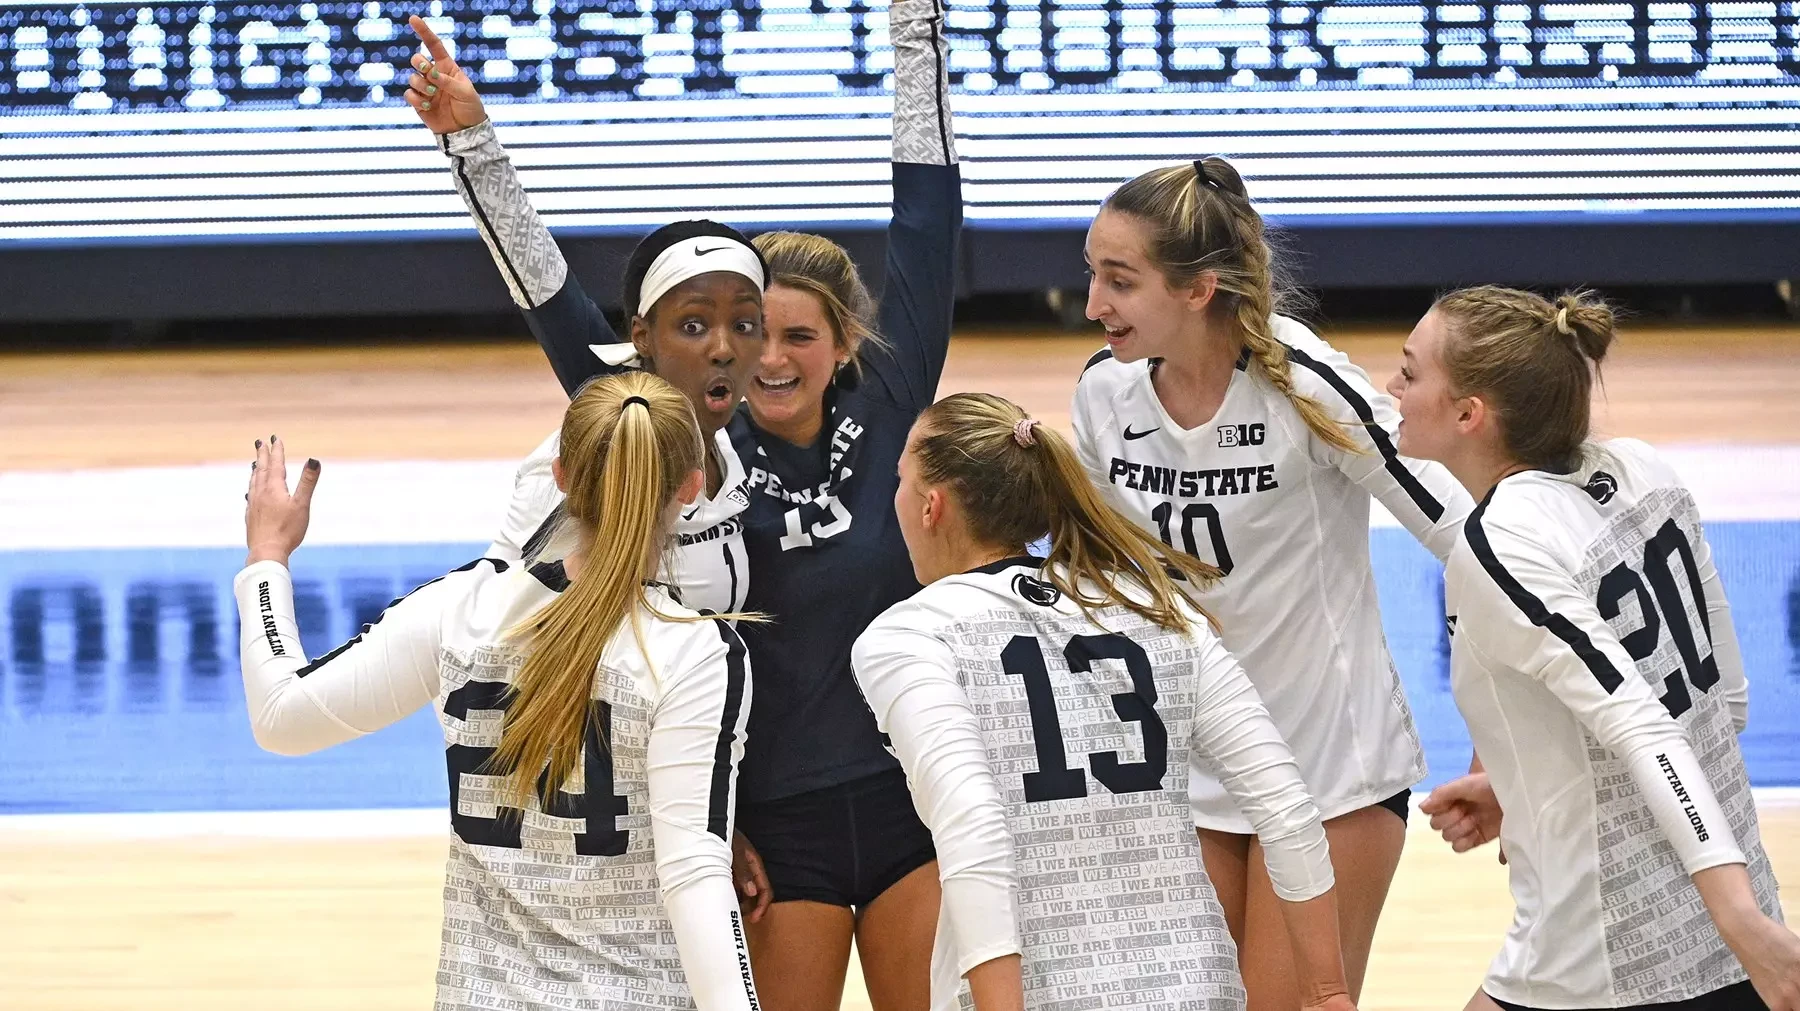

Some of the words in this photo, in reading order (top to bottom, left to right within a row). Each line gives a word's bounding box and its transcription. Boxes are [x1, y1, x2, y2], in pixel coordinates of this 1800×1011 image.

[1109, 457, 1176, 496] PENN
[1178, 464, 1278, 498] STATE
[259, 581, 272, 613] LIONS
[1597, 517, 1721, 720] 20
[1000, 631, 1167, 803] 13
[1656, 753, 1692, 803] NITTANY
[1684, 803, 1710, 844] LIONS
[731, 910, 744, 950] LIONS
